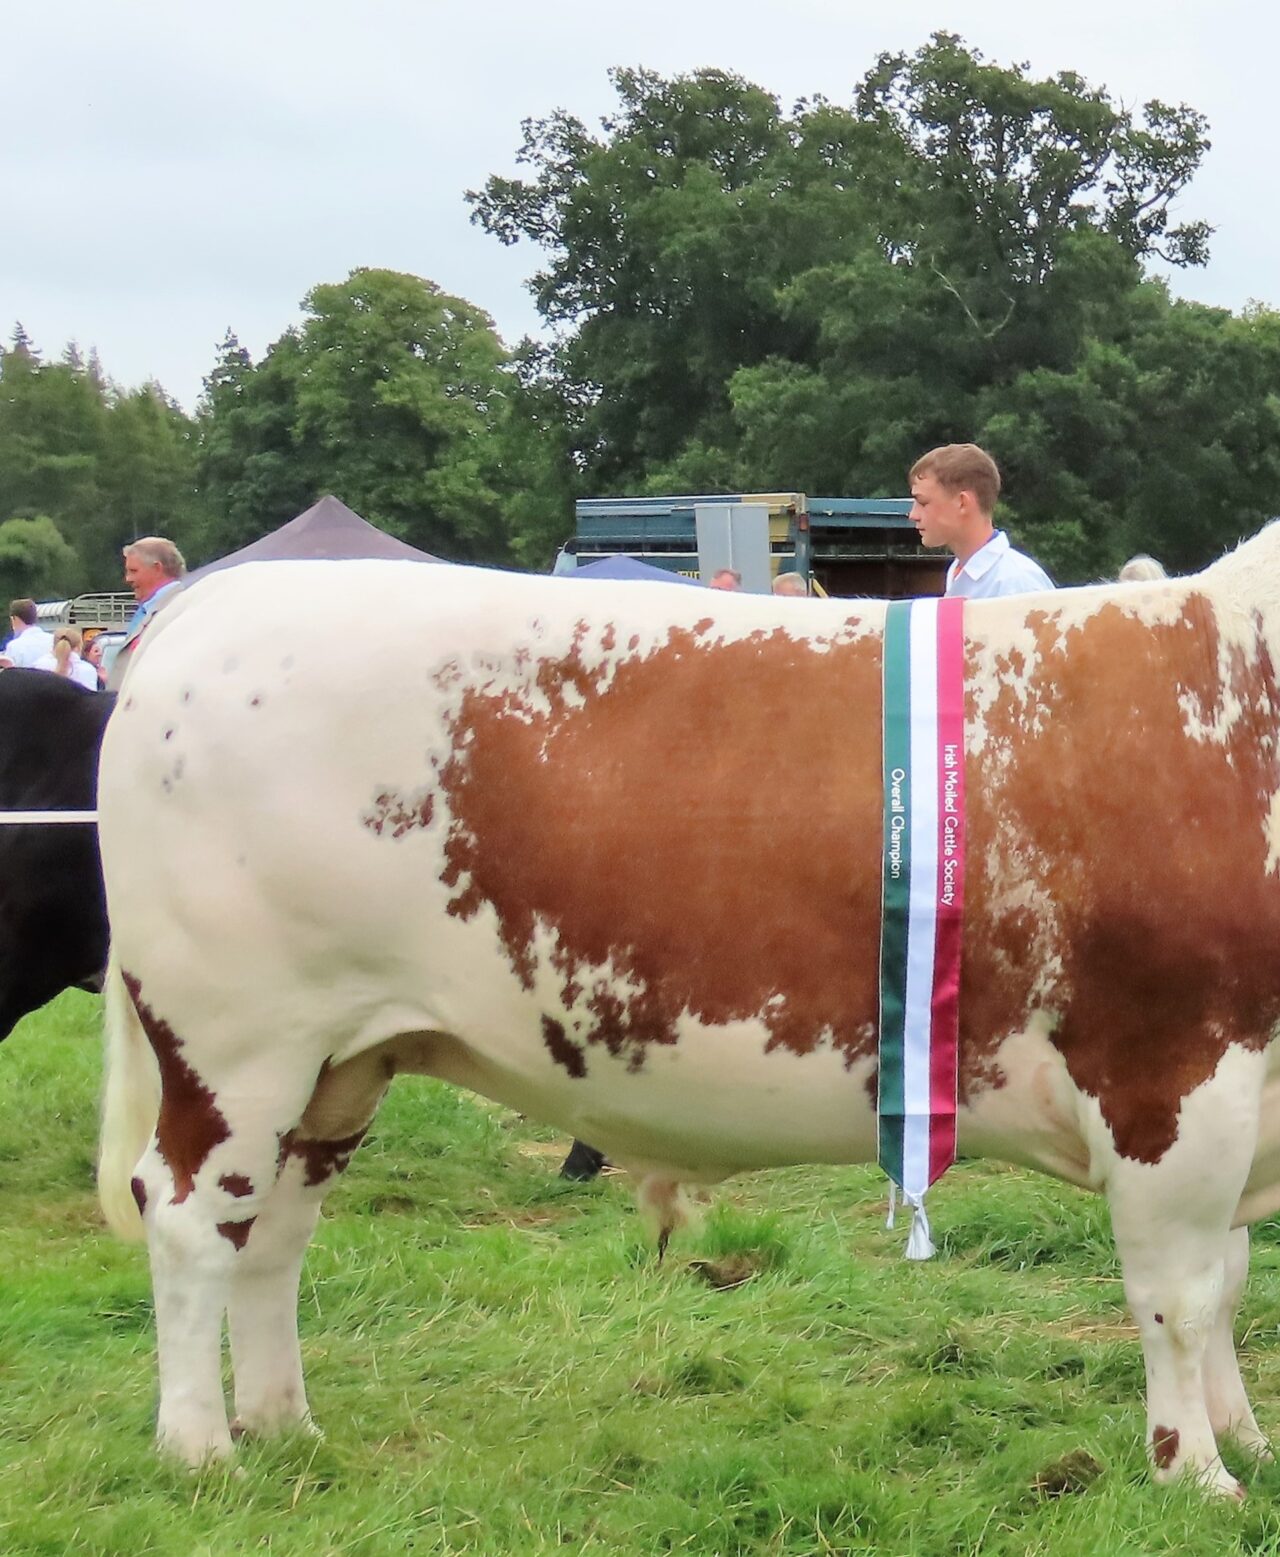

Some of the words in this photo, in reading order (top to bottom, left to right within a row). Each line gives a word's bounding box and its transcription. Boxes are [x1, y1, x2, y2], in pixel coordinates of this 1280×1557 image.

[944, 744, 958, 769] Irish
[891, 768, 905, 813] Overall
[944, 771, 958, 813] Moiled
[888, 816, 905, 879] Champion
[944, 816, 958, 856] Cattle
[941, 859, 958, 906] Society
